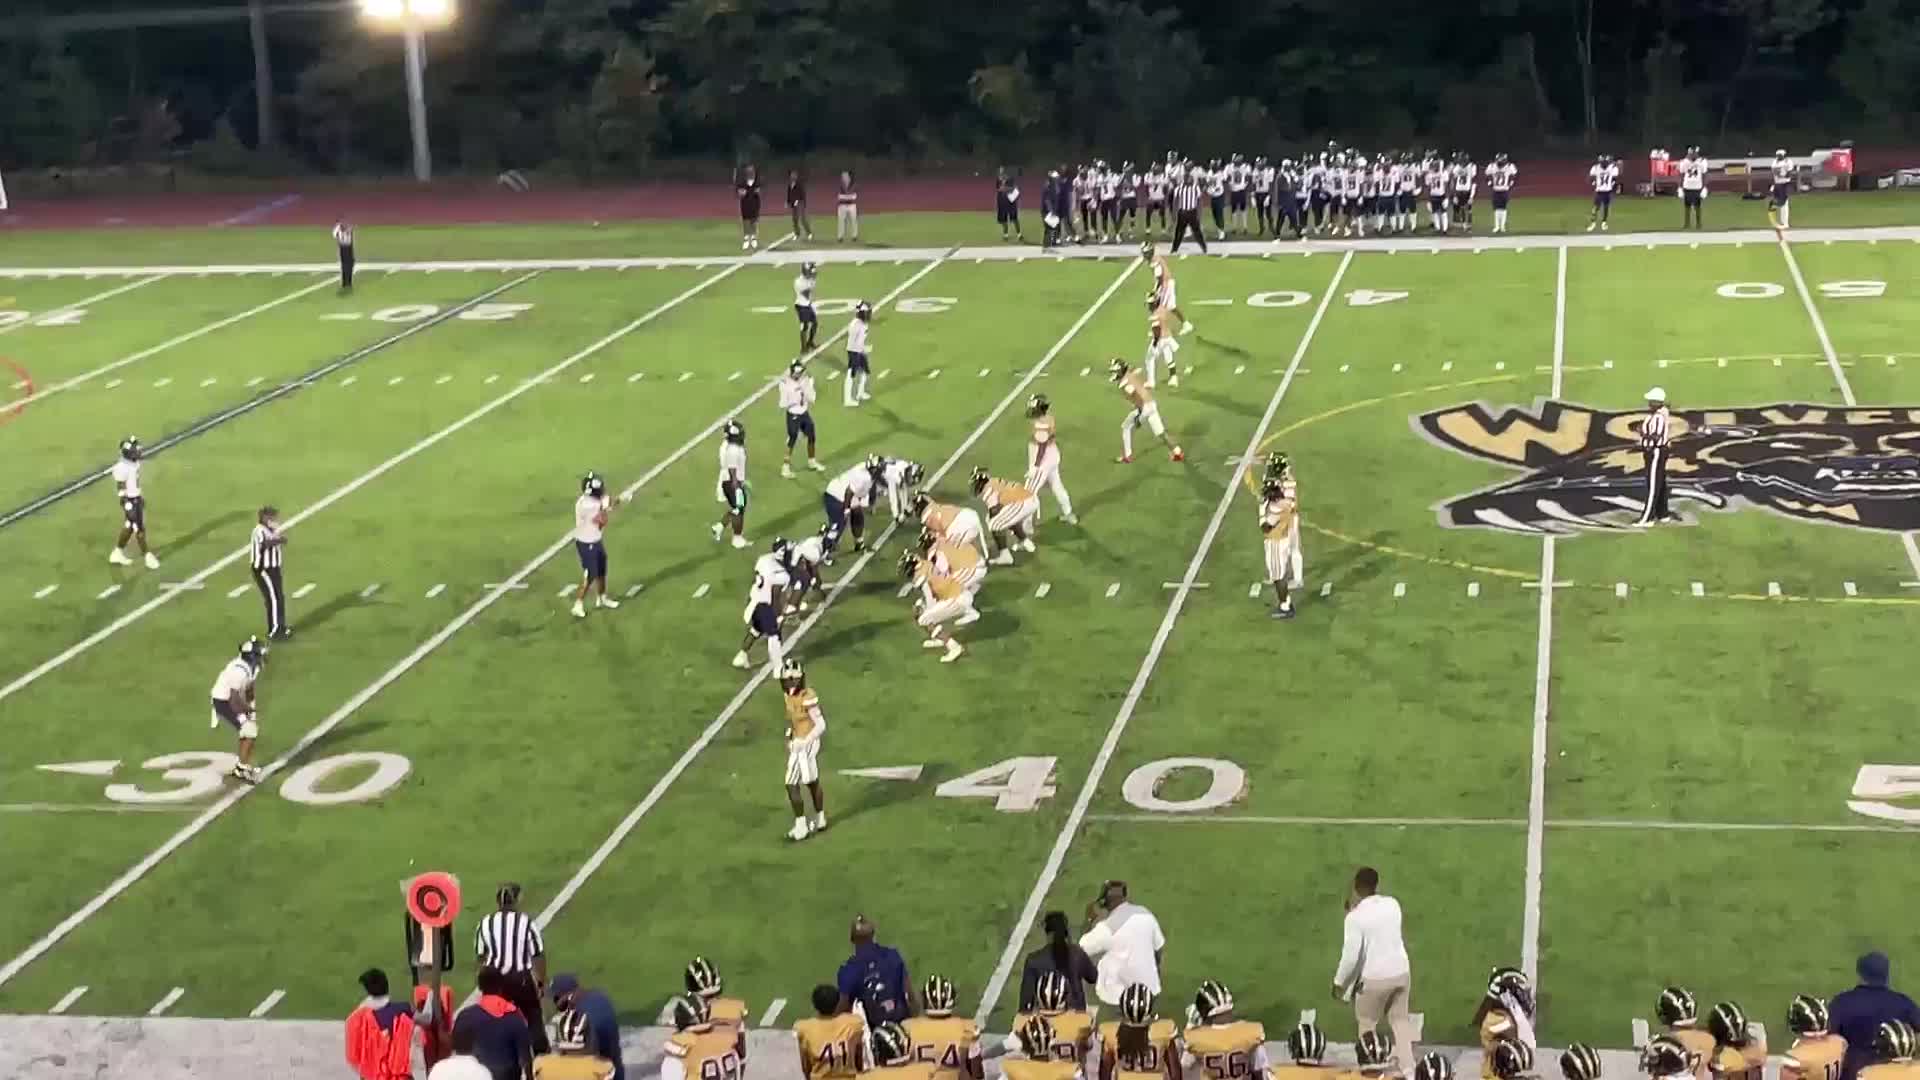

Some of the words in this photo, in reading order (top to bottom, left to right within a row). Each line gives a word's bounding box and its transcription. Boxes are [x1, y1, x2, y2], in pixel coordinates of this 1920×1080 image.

[1247, 289, 1409, 307] 40
[1716, 281, 1888, 299] 50
[105, 751, 412, 804] 30
[935, 756, 1248, 812] 40
[818, 1040, 848, 1069] 41
[1204, 1050, 1249, 1079] 56
